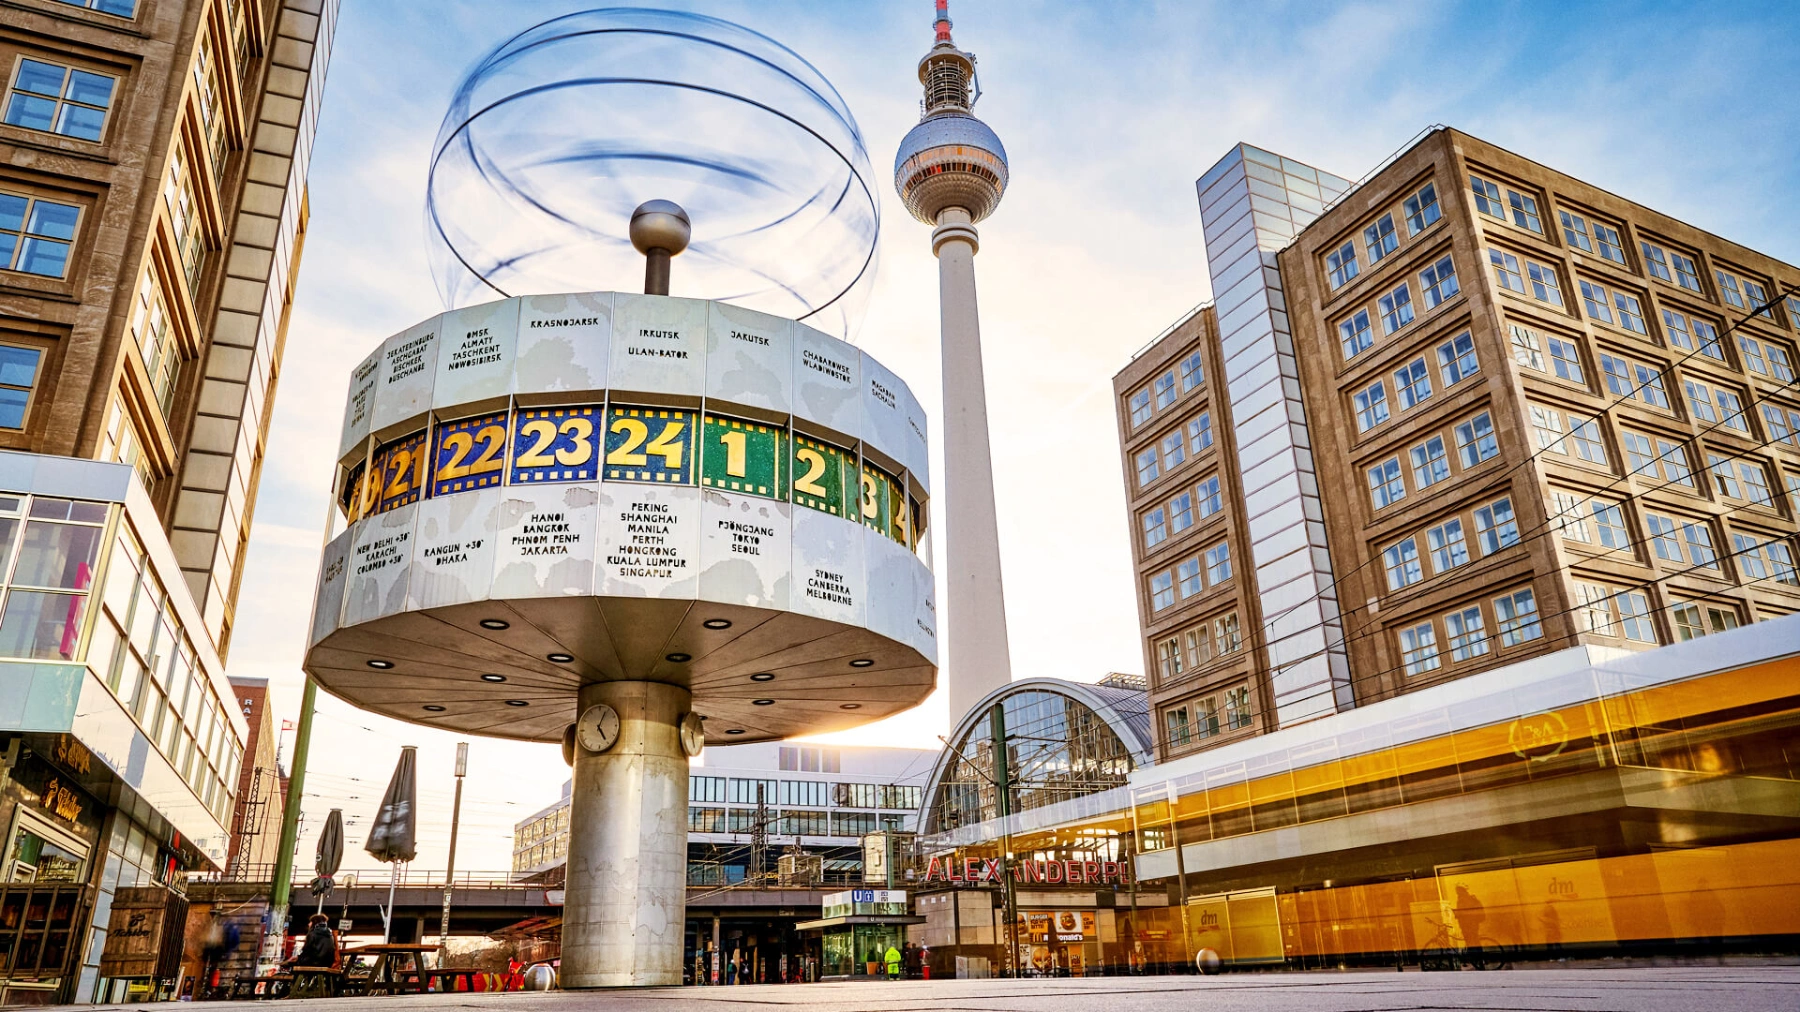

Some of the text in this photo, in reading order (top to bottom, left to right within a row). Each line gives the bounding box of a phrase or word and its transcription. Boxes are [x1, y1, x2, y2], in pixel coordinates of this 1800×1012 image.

[530, 317, 599, 329] KRASNOJARSK
[466, 328, 489, 339] OMSK
[639, 329, 680, 340] IRKUTSK
[730, 330, 770, 346] JAKUTSK
[386, 332, 435, 360] JEKATERINBURG
[460, 336, 494, 350] ALMATY
[391, 344, 428, 366] ASCHGABAT
[452, 344, 501, 361] TASCHKENT
[628, 347, 688, 359] ULAN-BATOR
[448, 353, 502, 371] NOWOSIBIRSK
[803, 350, 851, 374] CHABAROWSK
[388, 362, 426, 385] DUSCHANBE
[802, 358, 852, 384] WLADIWOSTOK
[516, 418, 594, 468] 23
[606, 418, 685, 469] 24
[437, 425, 506, 481] 22
[720, 431, 746, 478] 1
[383, 442, 426, 500] 21
[794, 448, 826, 498] 2
[862, 473, 878, 519] 3
[631, 502, 668, 513] PEKING
[530, 513, 565, 523] HANOI
[620, 513, 678, 524] SHANGHAI
[523, 524, 570, 534] BANGKOK
[627, 524, 670, 534] MANILA
[718, 520, 774, 537] PJÖNGJANG
[356, 543, 371, 556] NEW
[374, 537, 394, 550] DELHI
[511, 534, 580, 545] PHNOM PENH
[632, 535, 664, 545] PERTH
[732, 533, 760, 545] TOKYO
[366, 546, 397, 562] KARACHI
[424, 543, 461, 558] RANGUN
[520, 545, 569, 556] JAKARTA
[619, 545, 677, 556] HONGKONG
[731, 544, 760, 556] SEOUL
[357, 559, 387, 575] COLOMBO
[435, 553, 468, 566] DHAKA
[606, 556, 686, 568] KUALA LUMPUR
[619, 567, 673, 578] SINGAPUR
[815, 569, 843, 583] SYDNEY
[808, 578, 851, 595] CANBERRA
[806, 587, 852, 606] MELBOURNE
[853, 890, 862, 902] U
[1201, 909, 1218, 925] dm
